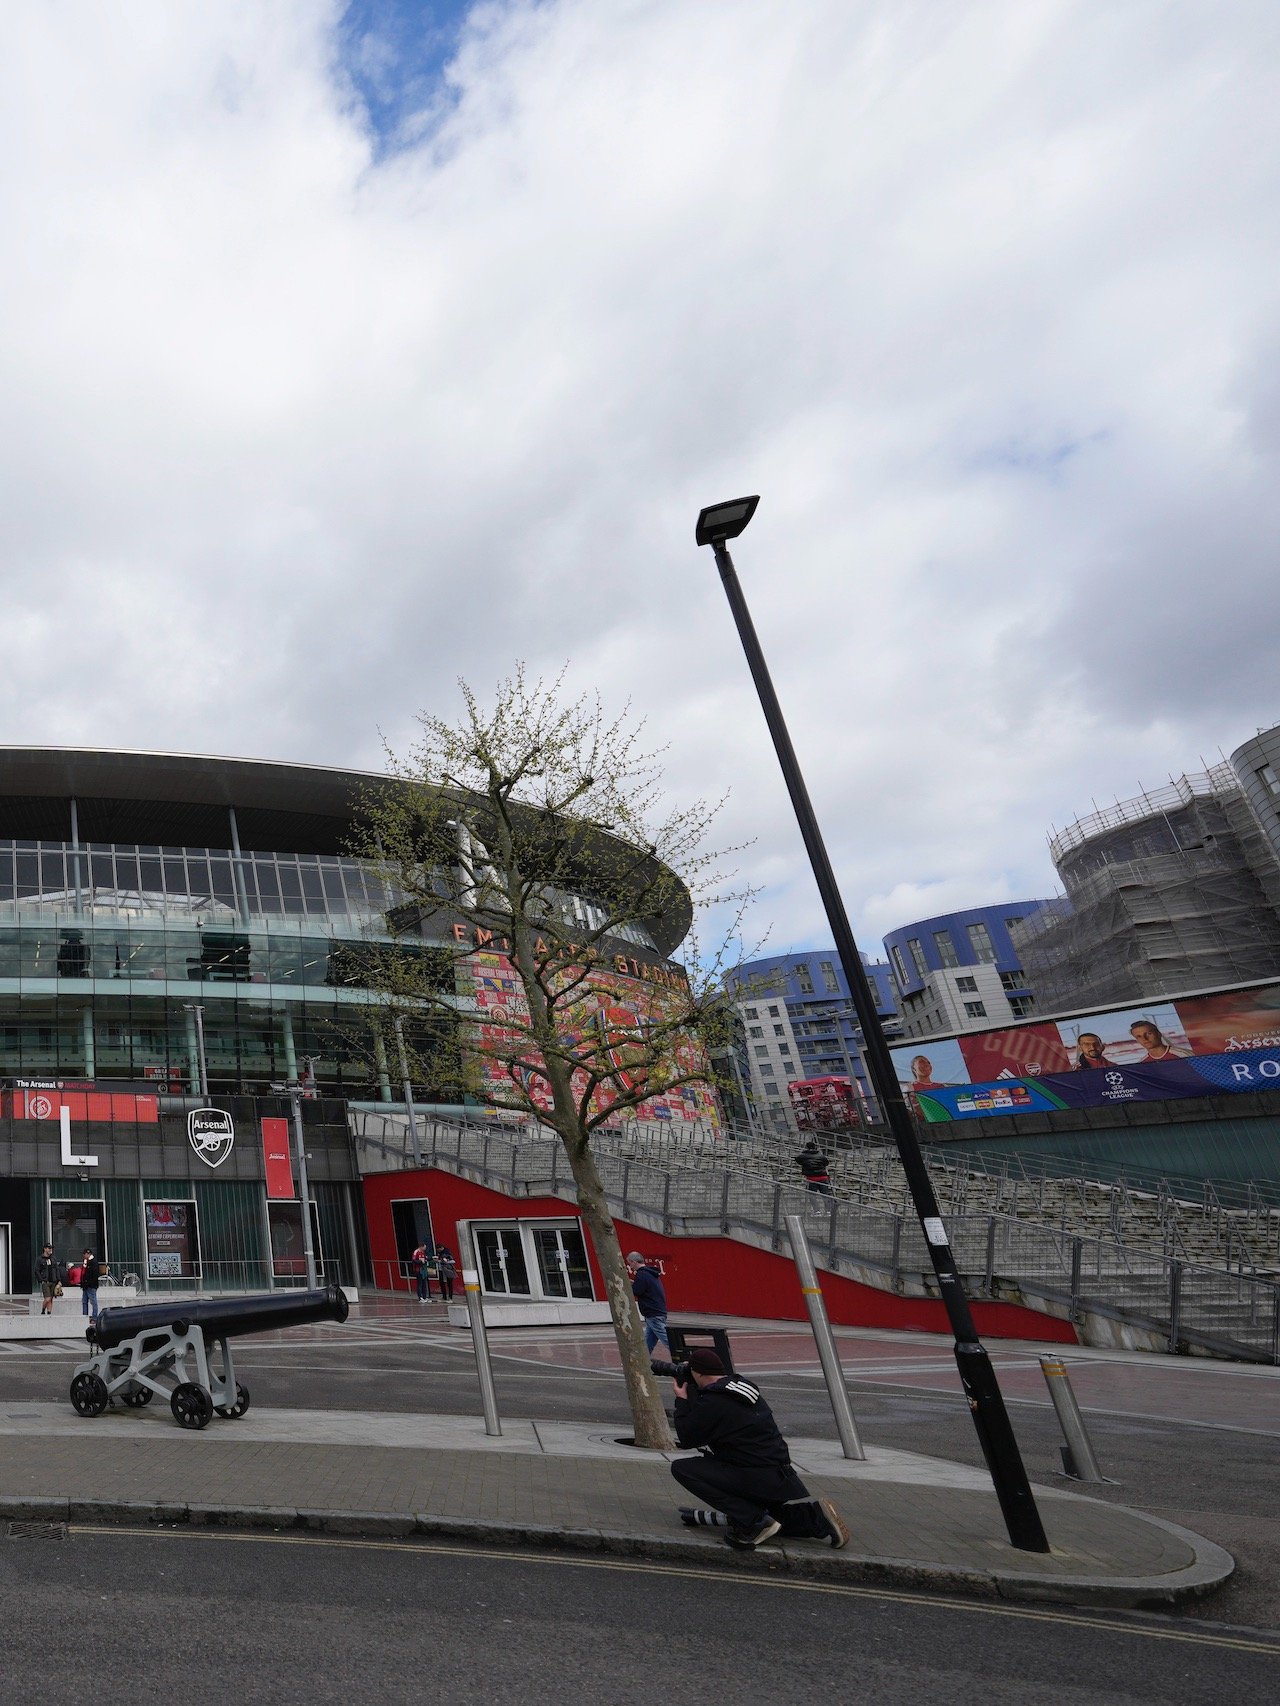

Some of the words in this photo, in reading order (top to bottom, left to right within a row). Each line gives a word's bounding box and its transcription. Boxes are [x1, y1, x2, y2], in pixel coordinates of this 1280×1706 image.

[16, 1079, 29, 1088] The
[30, 1080, 56, 1089] Arsenal
[1101, 1088, 1139, 1097] CHAMPIONS
[194, 1119, 228, 1130] Arsenal
